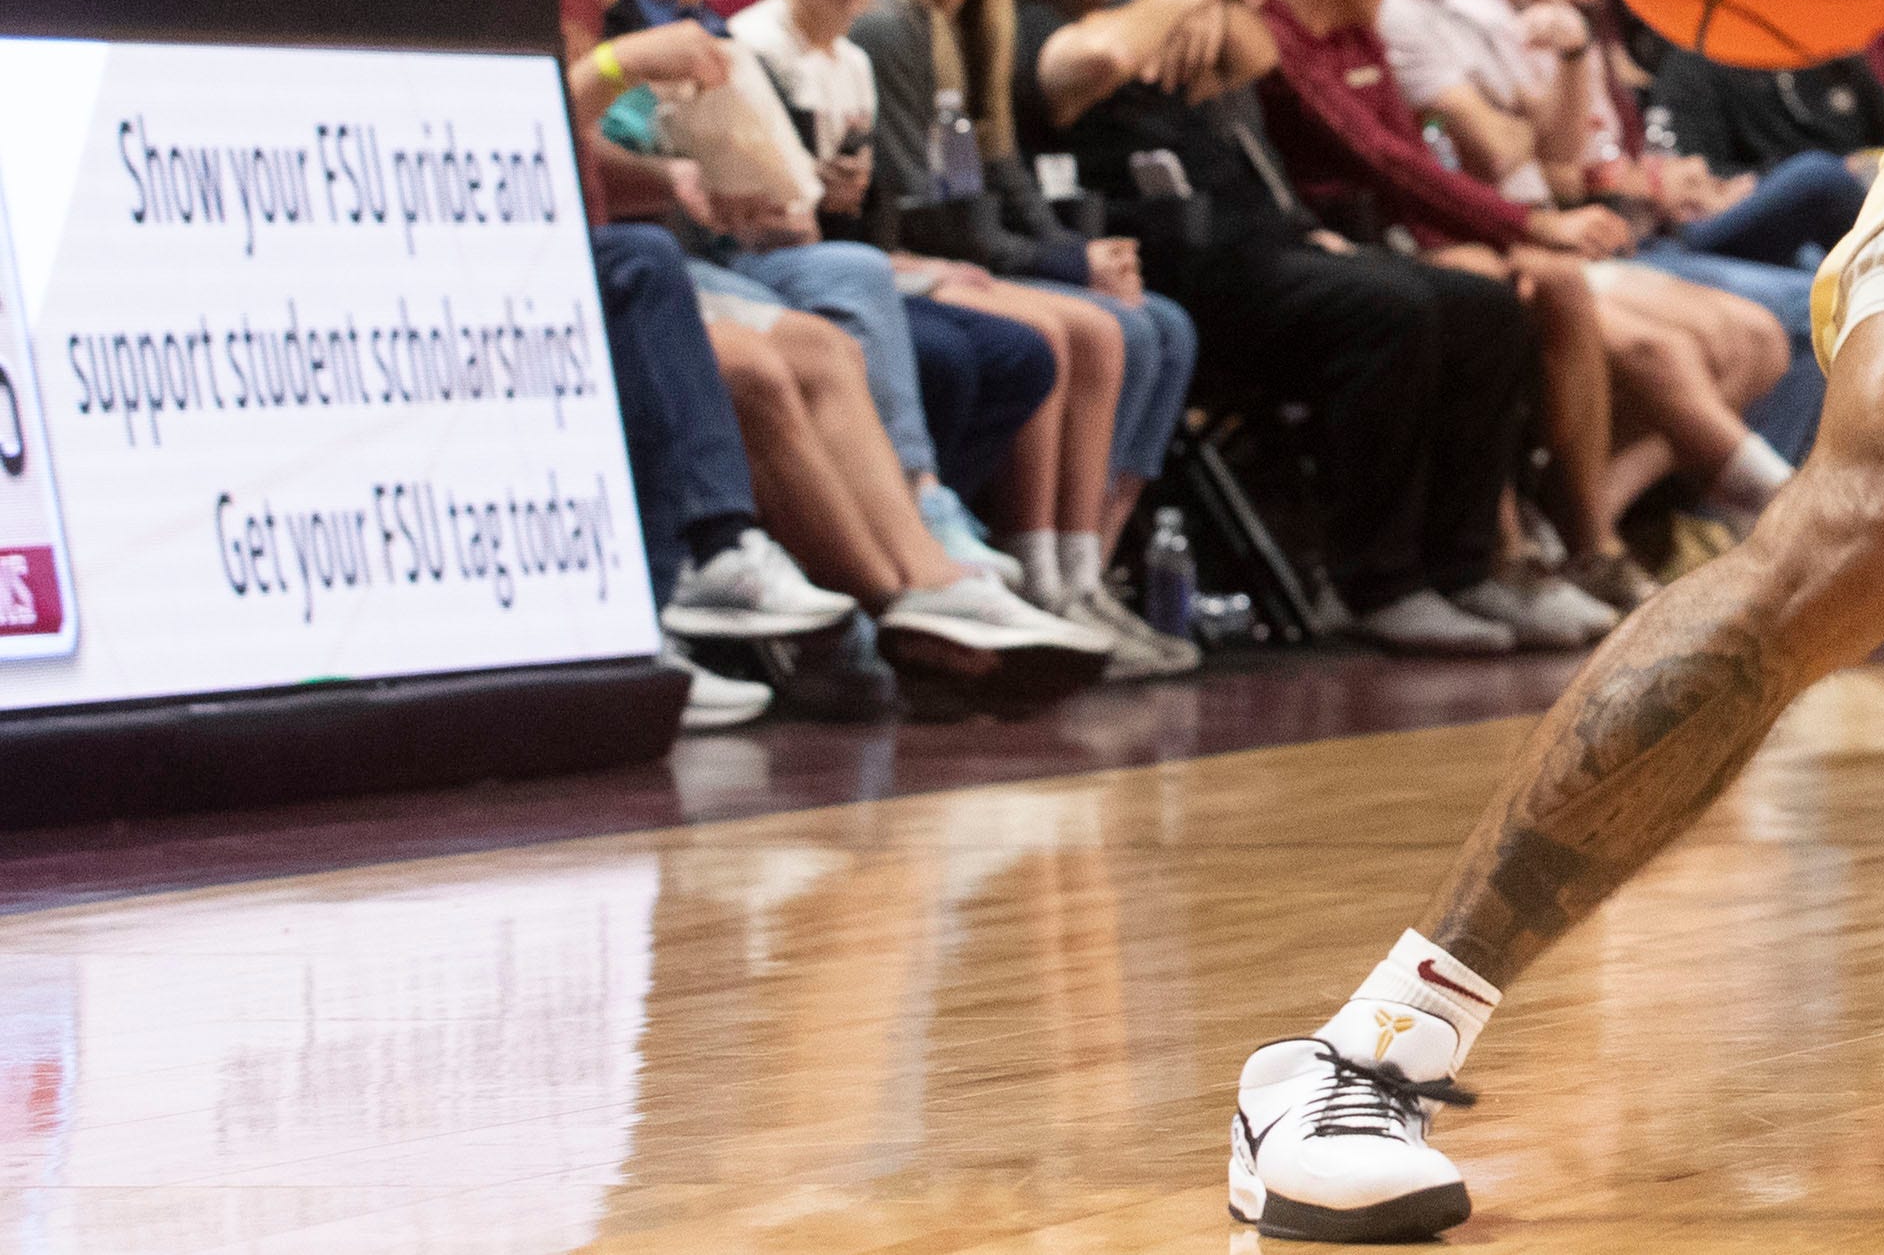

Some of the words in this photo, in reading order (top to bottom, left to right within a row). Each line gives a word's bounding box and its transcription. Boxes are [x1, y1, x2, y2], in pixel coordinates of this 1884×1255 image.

[119, 114, 226, 223] Show
[229, 147, 313, 256] your
[317, 123, 387, 223] FSU
[395, 120, 488, 255] pride
[491, 120, 557, 223] and
[69, 316, 224, 447] support
[226, 297, 372, 409] student
[373, 297, 597, 430] scholarships!
[217, 491, 288, 595] Get
[287, 511, 370, 623] your
[373, 483, 445, 583] FSU
[447, 490, 515, 609] tag
[507, 470, 619, 601] today!
